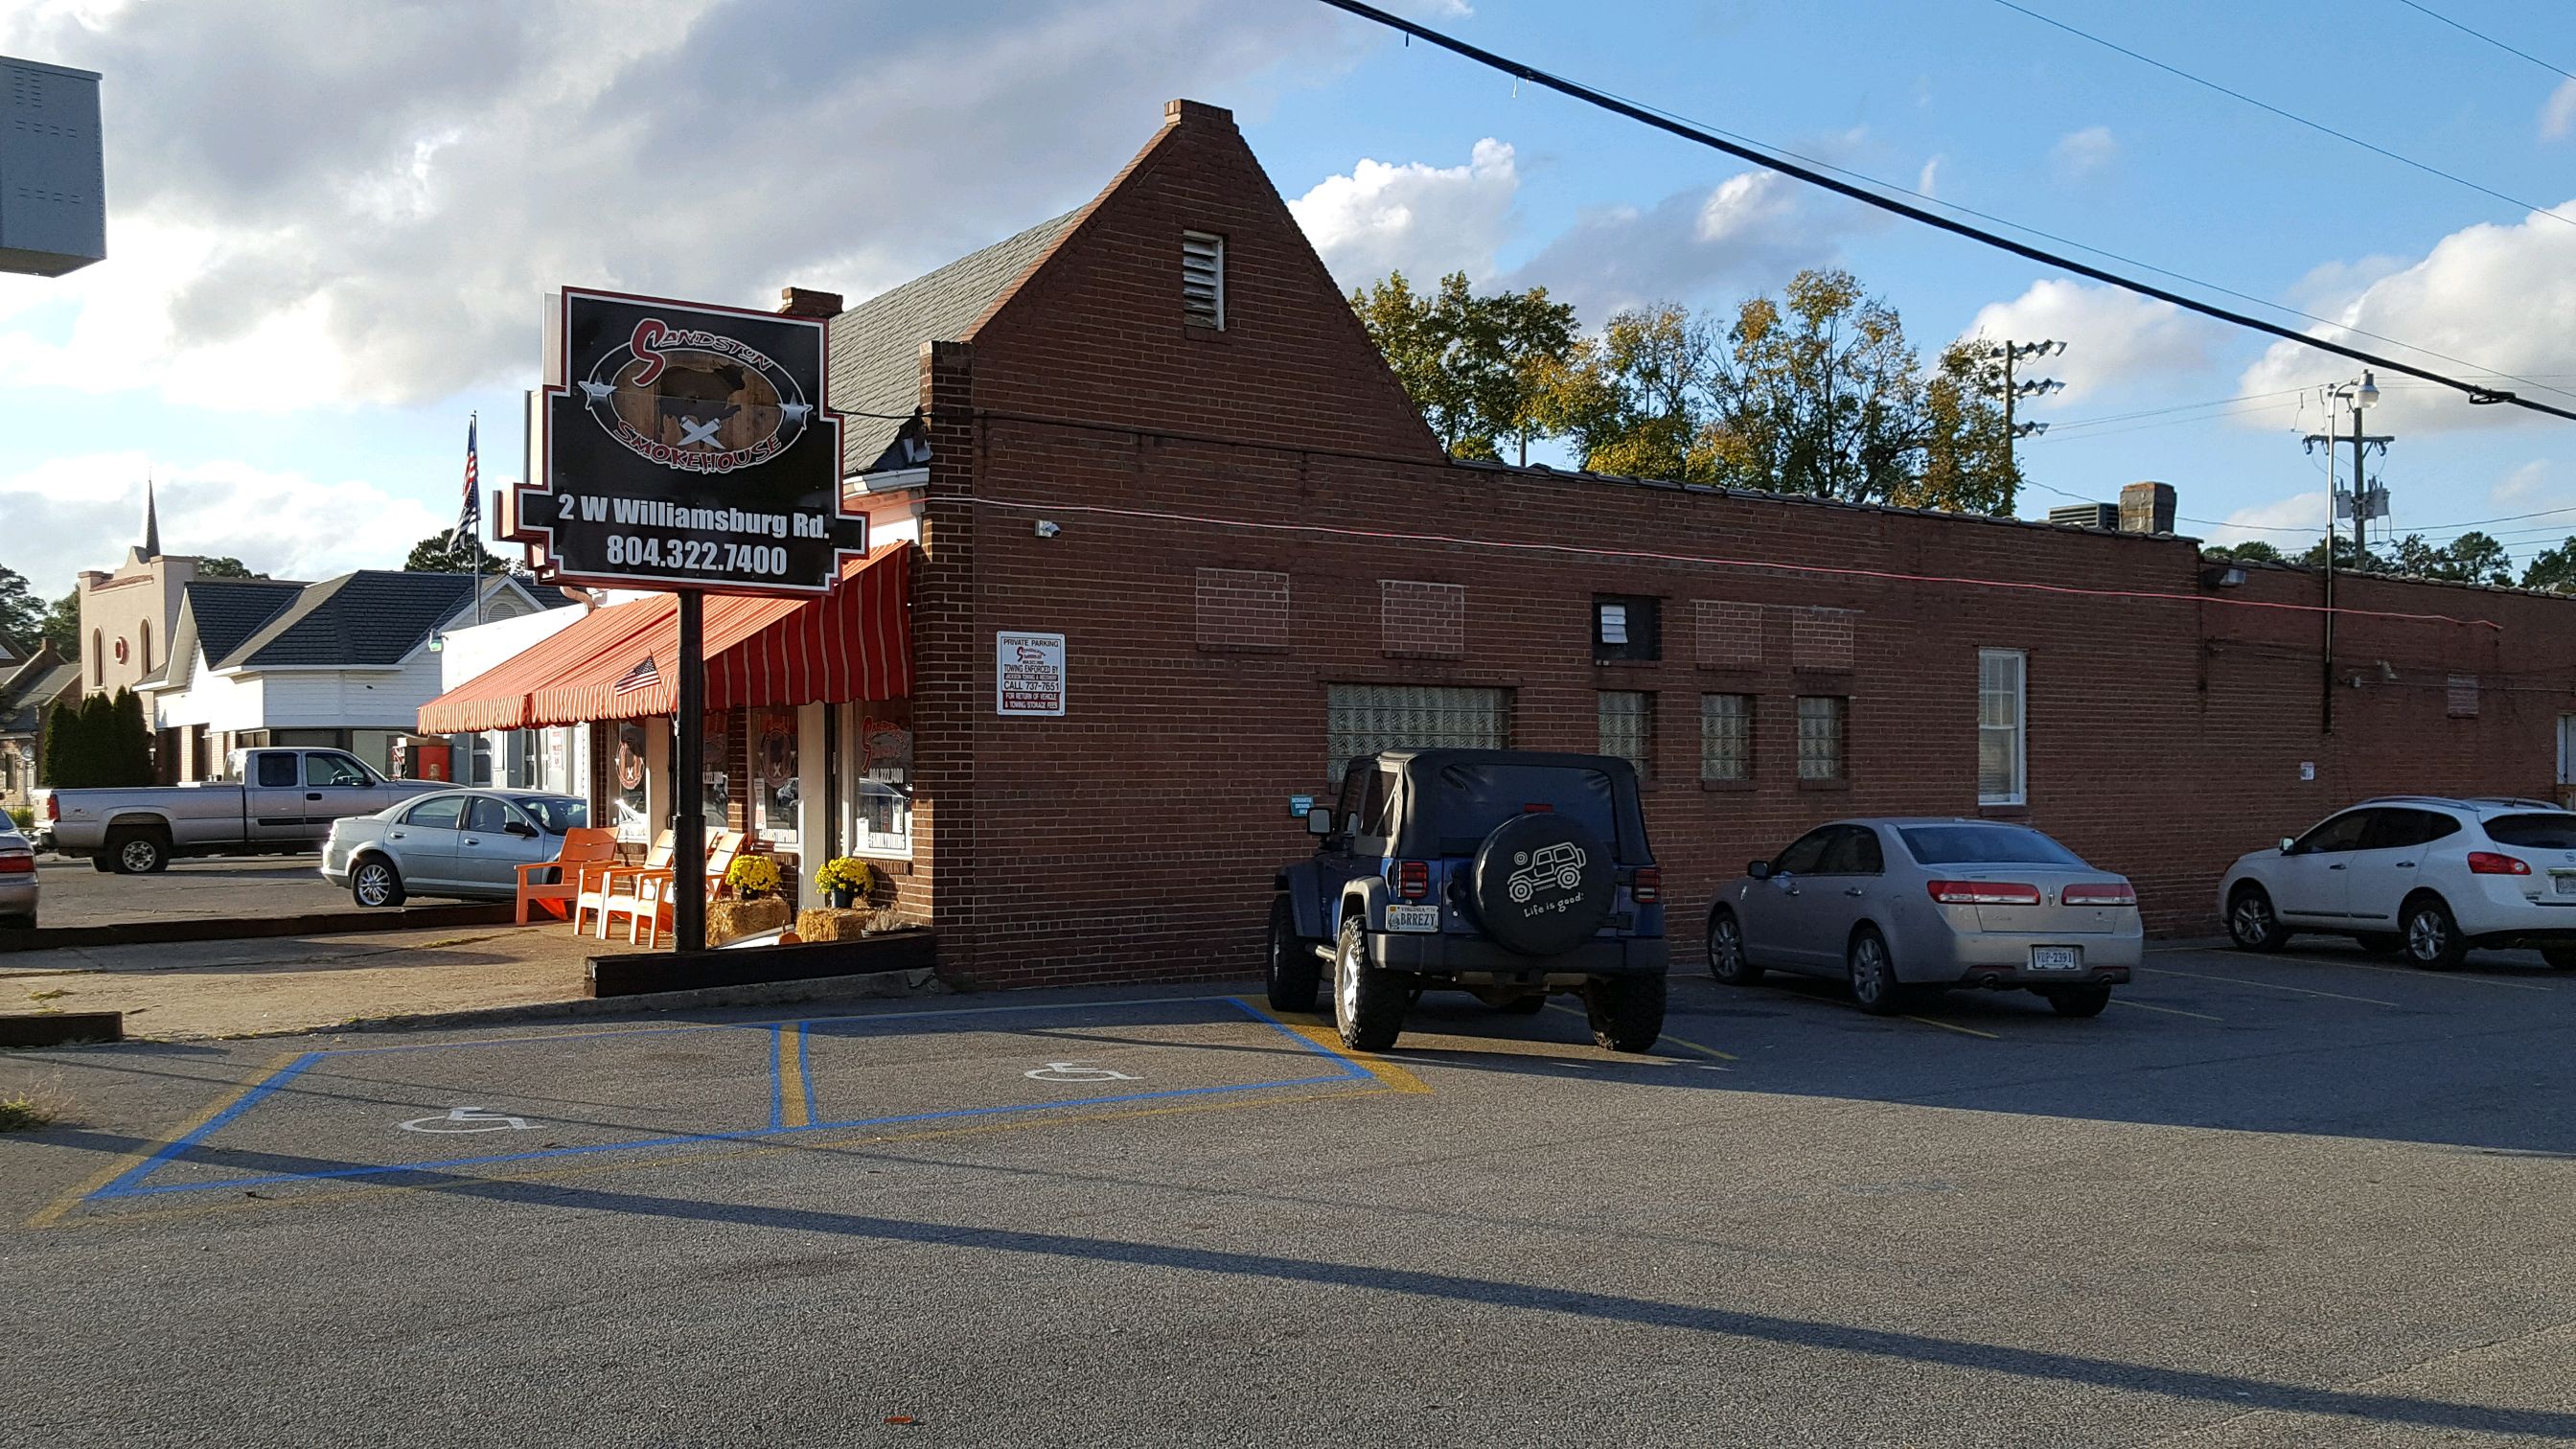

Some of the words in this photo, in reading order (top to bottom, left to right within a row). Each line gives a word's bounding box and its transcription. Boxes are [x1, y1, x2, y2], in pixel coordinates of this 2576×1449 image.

[614, 420, 782, 473] SMOKEHOUSE
[559, 494, 575, 519] 2
[581, 495, 608, 522] W
[613, 498, 788, 539] Williamsburg
[794, 513, 830, 539] Rd.
[607, 535, 788, 575] 804.322.7400
[1025, 681, 1059, 690] 737-7651
[1400, 913, 1436, 926] BRREZY
[1524, 904, 1545, 917] Life
